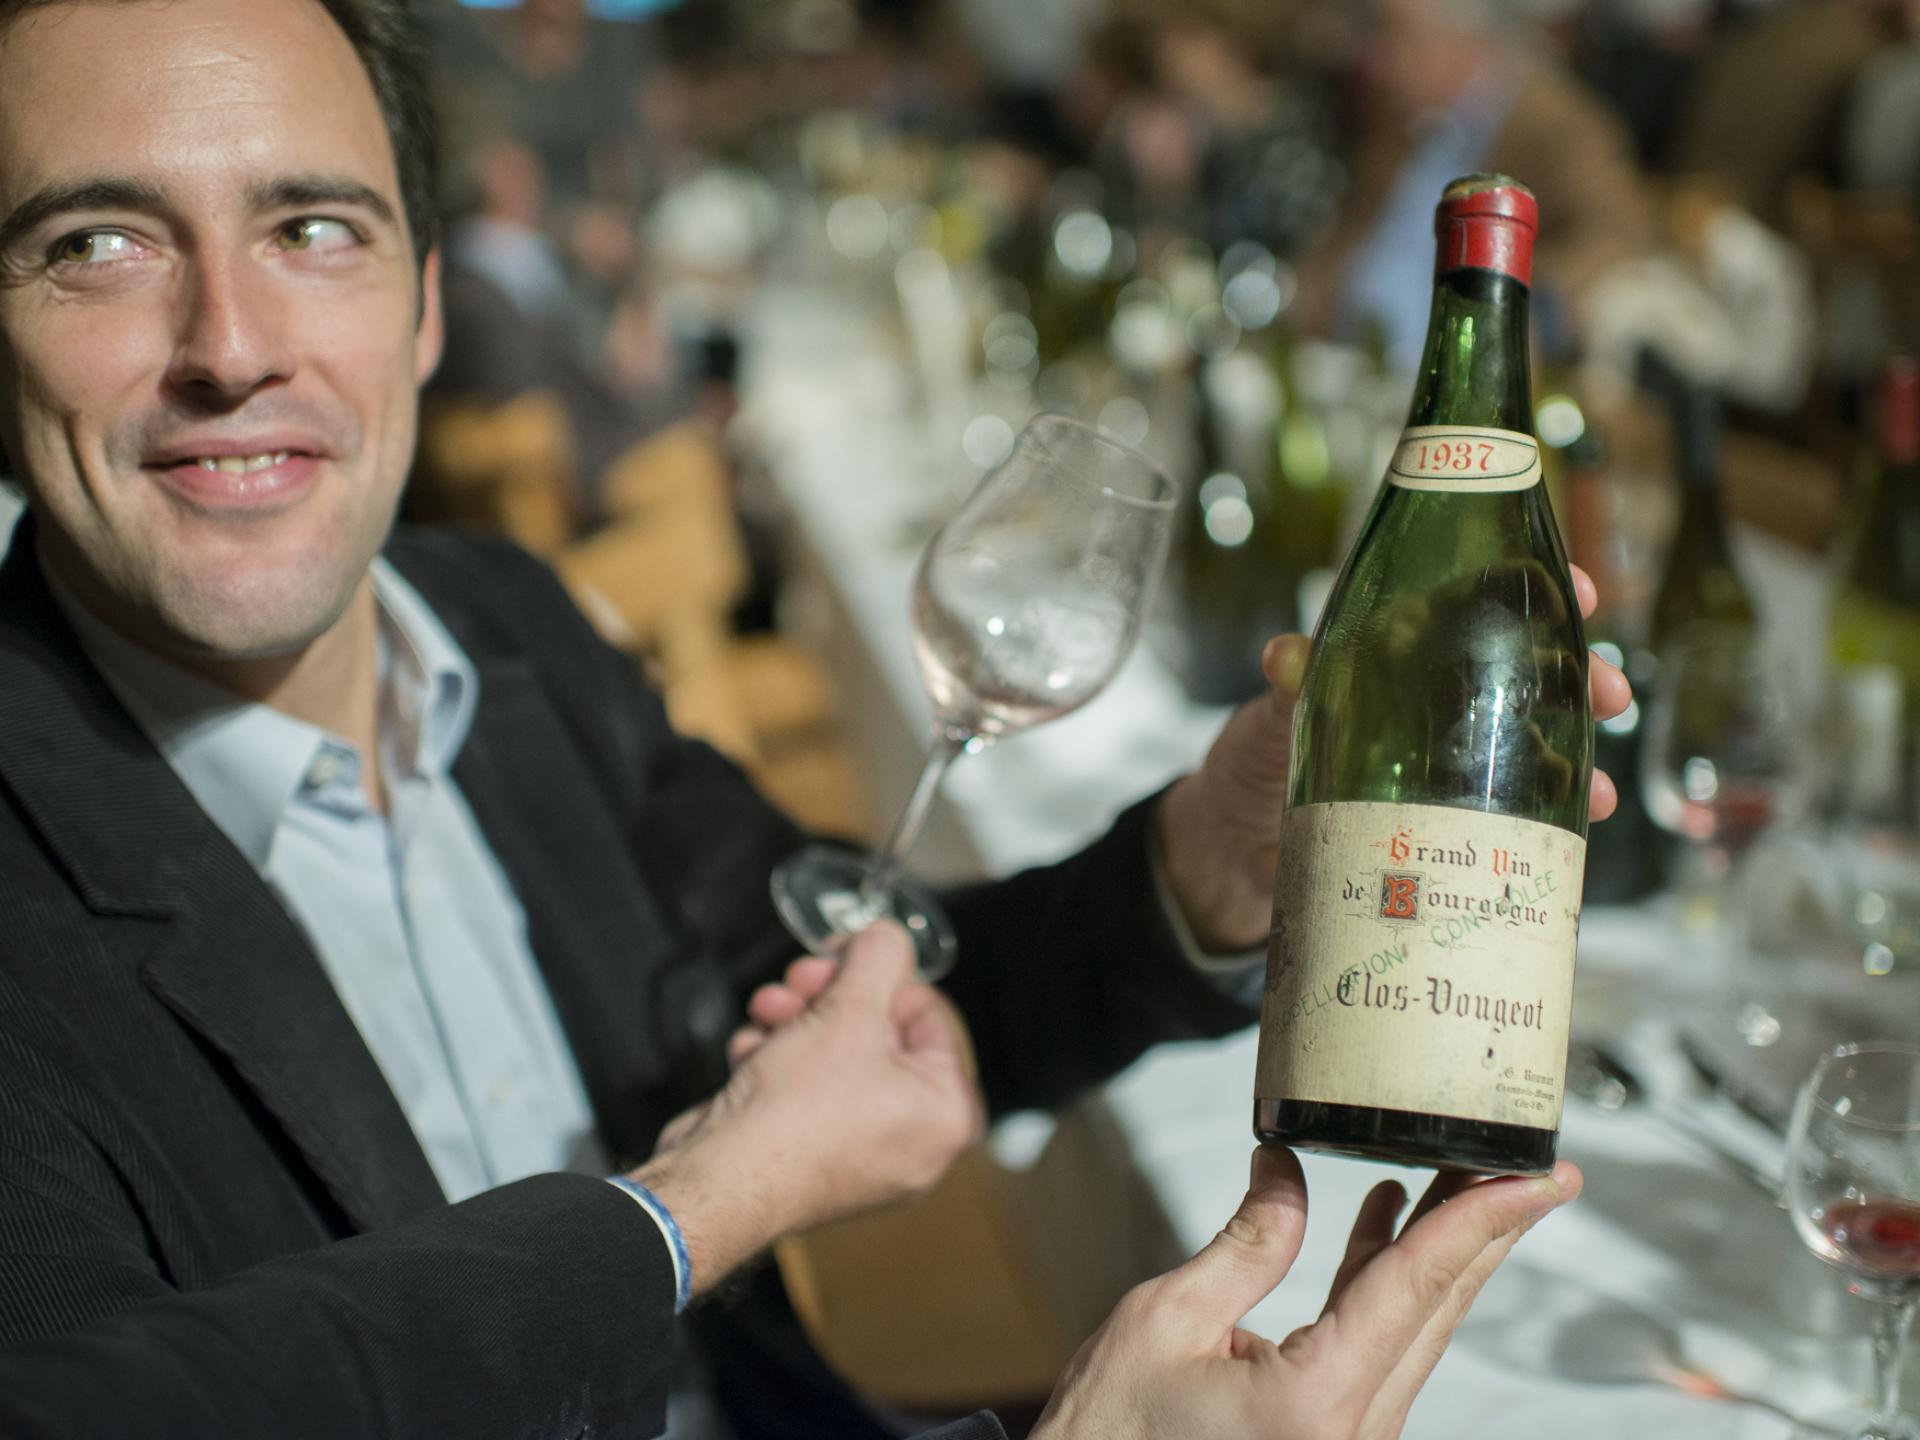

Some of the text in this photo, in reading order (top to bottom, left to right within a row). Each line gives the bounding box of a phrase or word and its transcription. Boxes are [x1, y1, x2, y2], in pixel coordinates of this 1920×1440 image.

[1418, 442, 1494, 471] 1937
[1390, 828, 1531, 877] Grand Vin
[1342, 879, 1365, 900] de
[1337, 971, 1543, 1033] Clos-Vougeot
